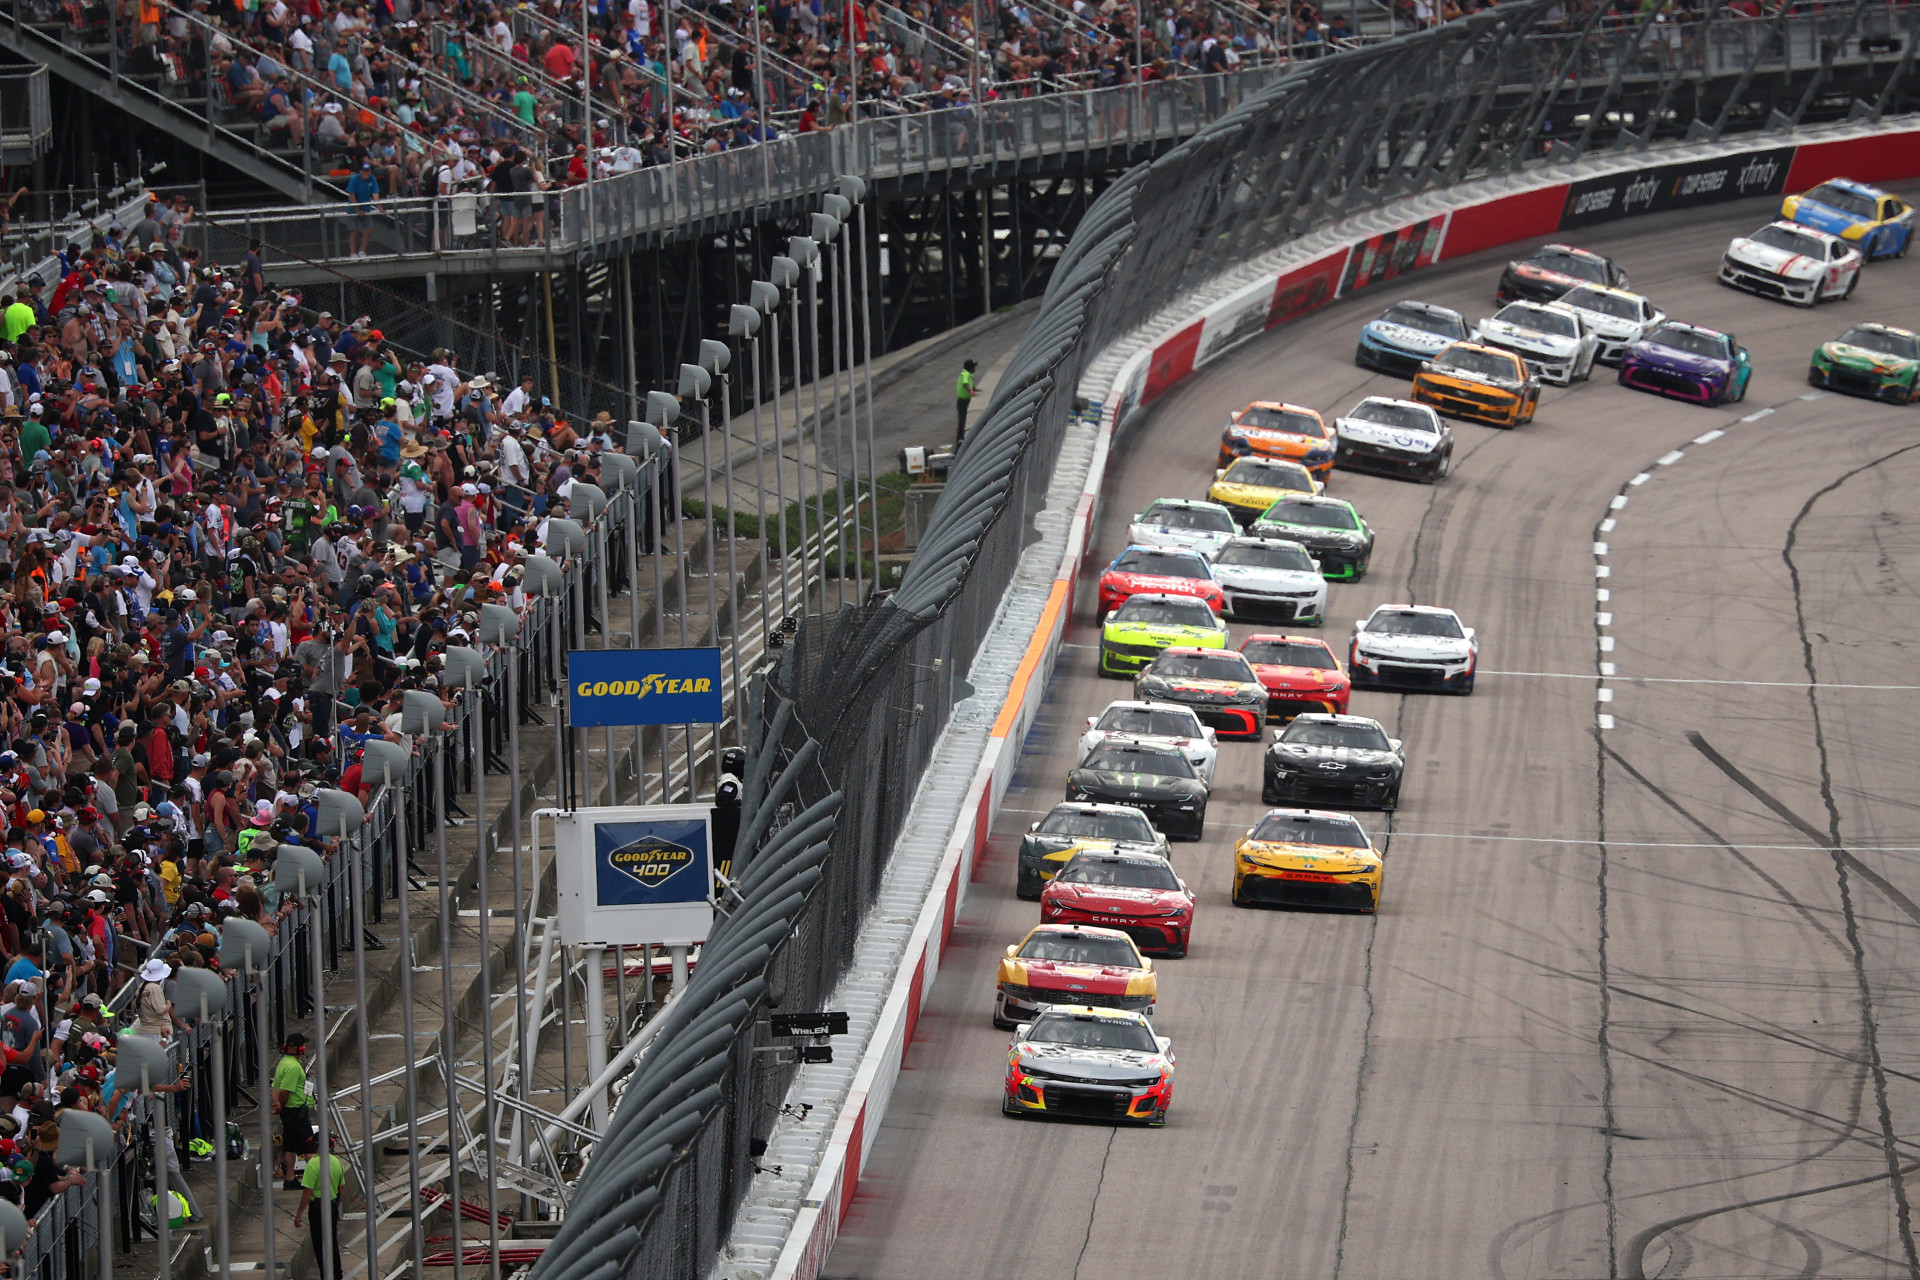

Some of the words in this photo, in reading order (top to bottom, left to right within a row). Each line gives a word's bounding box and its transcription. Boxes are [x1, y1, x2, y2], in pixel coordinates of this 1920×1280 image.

[1736, 157, 1780, 193] xfinity
[1622, 175, 1662, 212] xfinity
[284, 508, 294, 531] 1
[1130, 580, 1196, 594] Health
[577, 678, 712, 697] GOODYEAR
[1114, 801, 1156, 809] CAMRY
[615, 852, 687, 862] GOODYEAR
[1126, 859, 1161, 867] HAMLIN
[633, 864, 670, 876] 400
[1286, 873, 1331, 881] CAMRY
[1092, 916, 1137, 924] CAMRY
[1086, 934, 1120, 942] LOGANO
[1100, 1018, 1133, 1026] BYRON
[791, 1026, 829, 1035] WHELEN
[1020, 1076, 1035, 1085] 24
